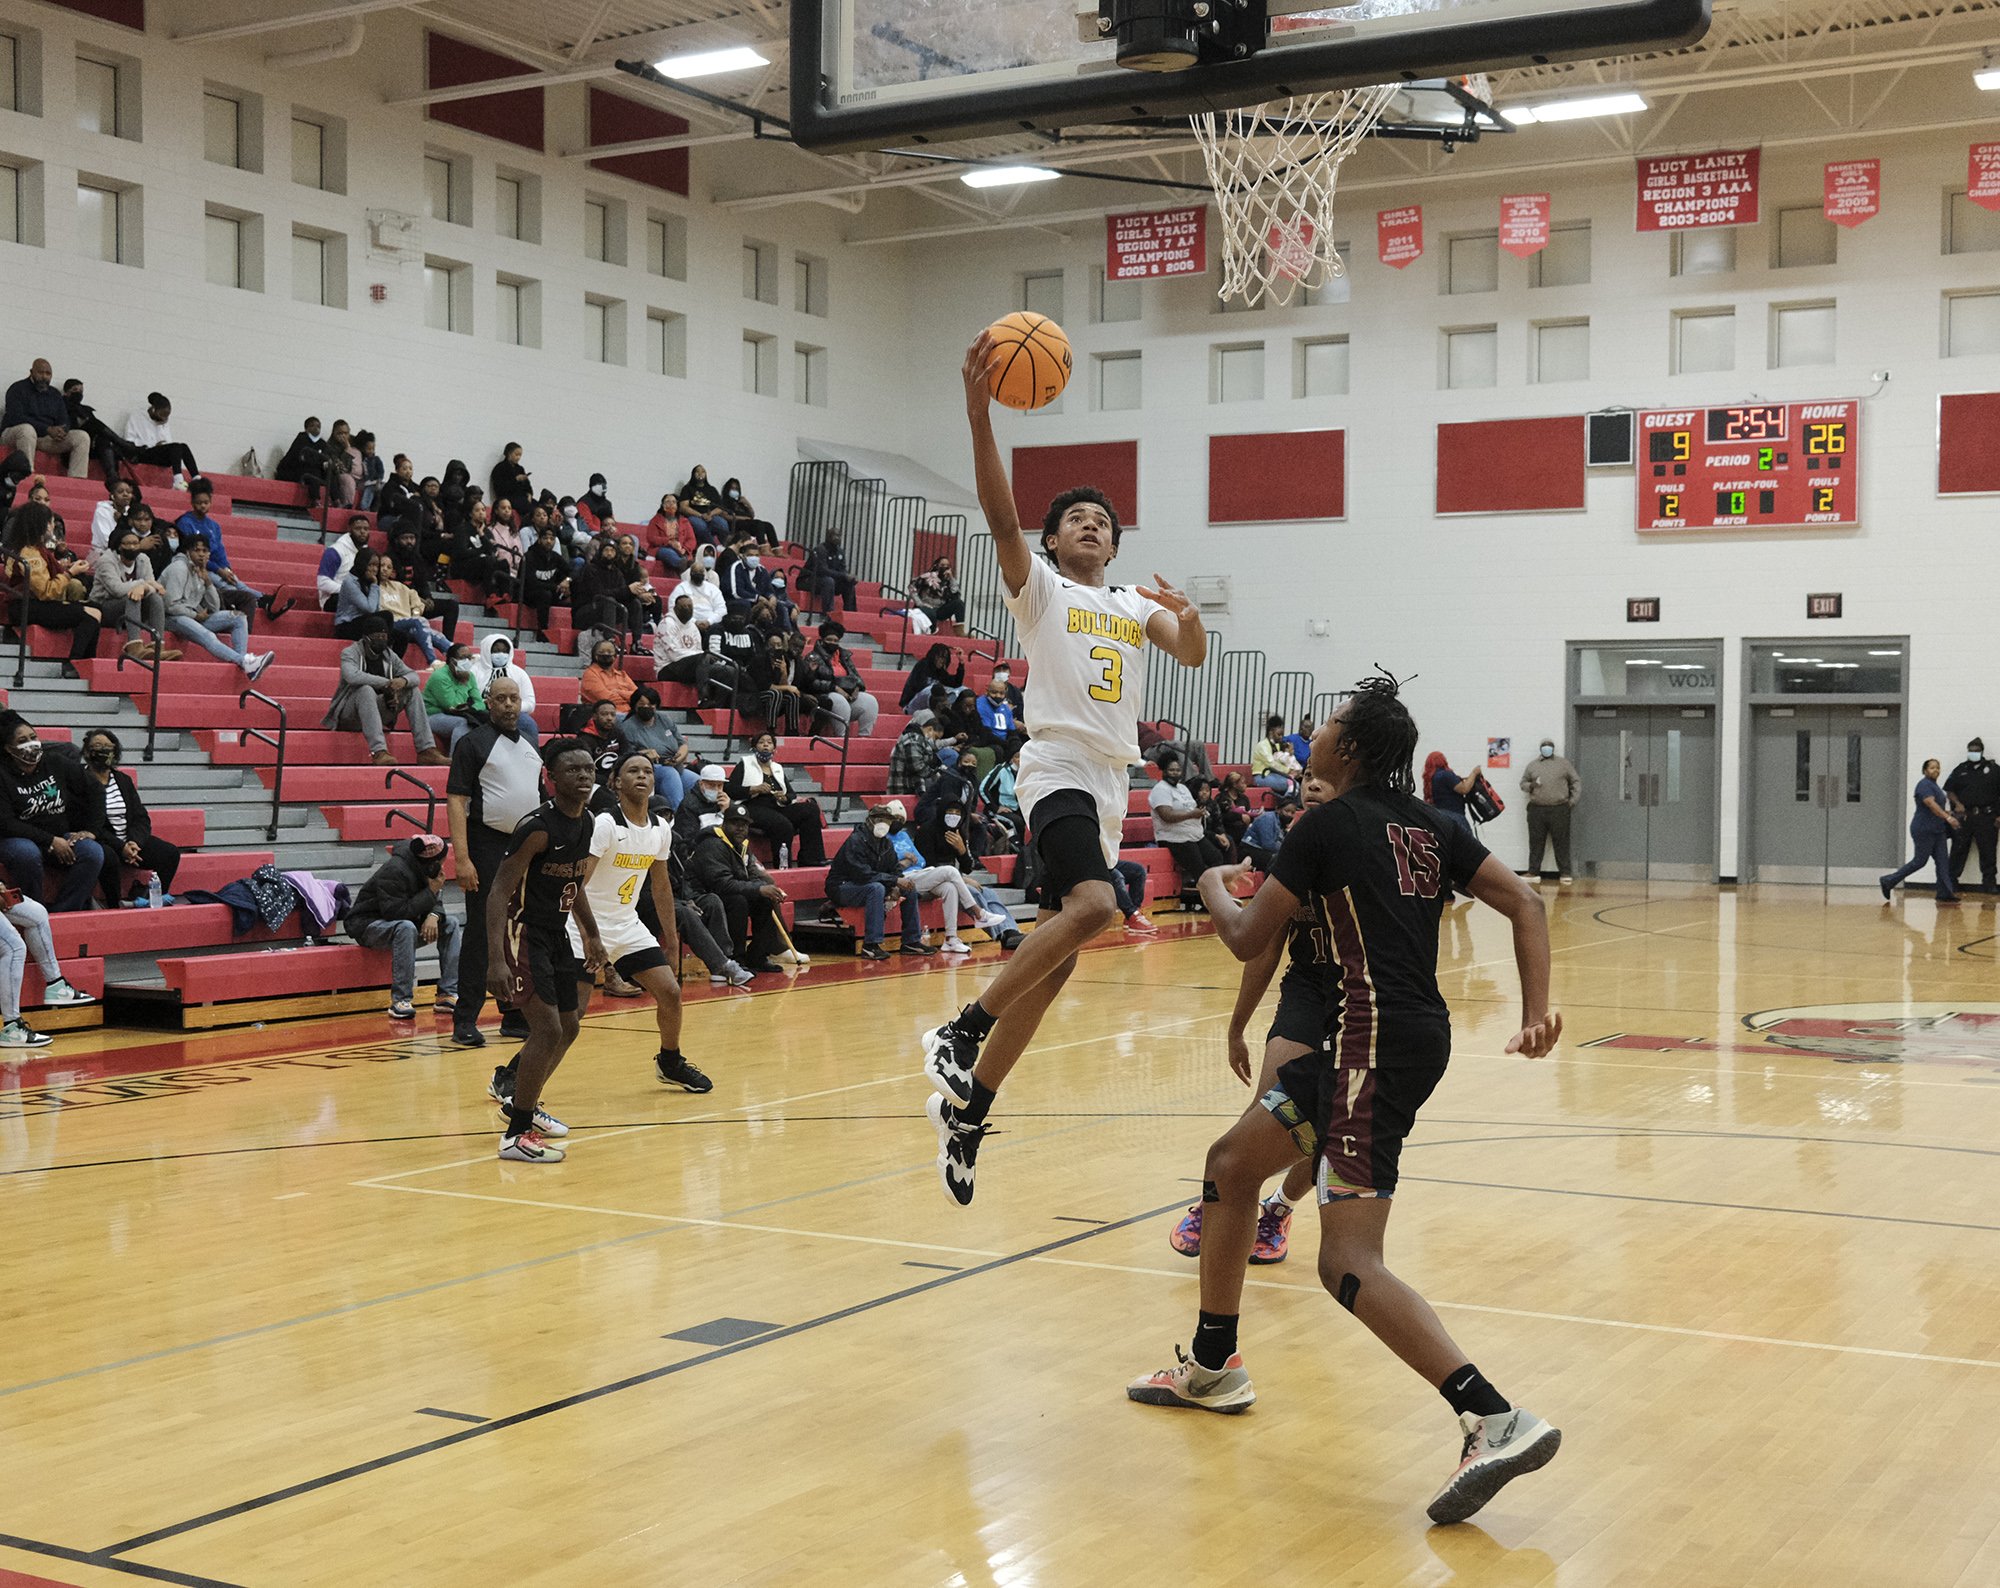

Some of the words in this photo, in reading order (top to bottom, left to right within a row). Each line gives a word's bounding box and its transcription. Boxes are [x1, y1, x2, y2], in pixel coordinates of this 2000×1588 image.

[1650, 161, 1688, 174] LUCY
[1695, 154, 1746, 170] LANEY
[1647, 175, 1677, 187] GIRLS
[1683, 168, 1749, 184] BASKETBALL
[1835, 176, 1870, 186] 3AA
[1643, 186, 1697, 201] REGION
[1702, 185, 1712, 197] 3
[1654, 196, 1740, 214] CHAMPIONS
[1837, 197, 1869, 208] 2009
[1384, 208, 1416, 219] GIRLS
[1509, 208, 1541, 216] 3AA
[1658, 209, 1735, 227] 2003-2004
[1117, 217, 1149, 229] LUCY
[1154, 212, 1196, 225] LANEY
[1381, 215, 1420, 228] TRACK
[1116, 229, 1152, 241] GIRLS
[1156, 223, 1198, 237] TRACK
[1117, 240, 1160, 253] REGION
[1164, 239, 1173, 249] 7
[1122, 249, 1190, 265] CHAMPIONS
[1117, 265, 1147, 277] 2005
[1151, 264, 1160, 274] &
[1801, 404, 1849, 419] HOME
[1645, 412, 1696, 428] GUEST
[1726, 408, 1784, 439] 2:54
[1673, 431, 1690, 460] 9
[1809, 423, 1846, 454] 26
[1705, 454, 1751, 467] PERIOD
[1758, 447, 1773, 470] 2
[1655, 483, 1685, 493] FOULS
[1808, 477, 1840, 487] FOULS
[1665, 494, 1679, 517] 2
[1819, 488, 1834, 511] 2
[1652, 518, 1686, 528] POINTS
[1713, 516, 1748, 526] MATCH
[1805, 512, 1840, 522] POINTS
[1633, 602, 1653, 617] EXIT
[1813, 598, 1835, 613] EXIT
[1088, 646, 1122, 704] 3
[1387, 823, 1441, 899] 15
[559, 881, 578, 913] 2
[617, 874, 639, 905] 4
[515, 976, 524, 992] C
[1341, 1135, 1358, 1158] C
